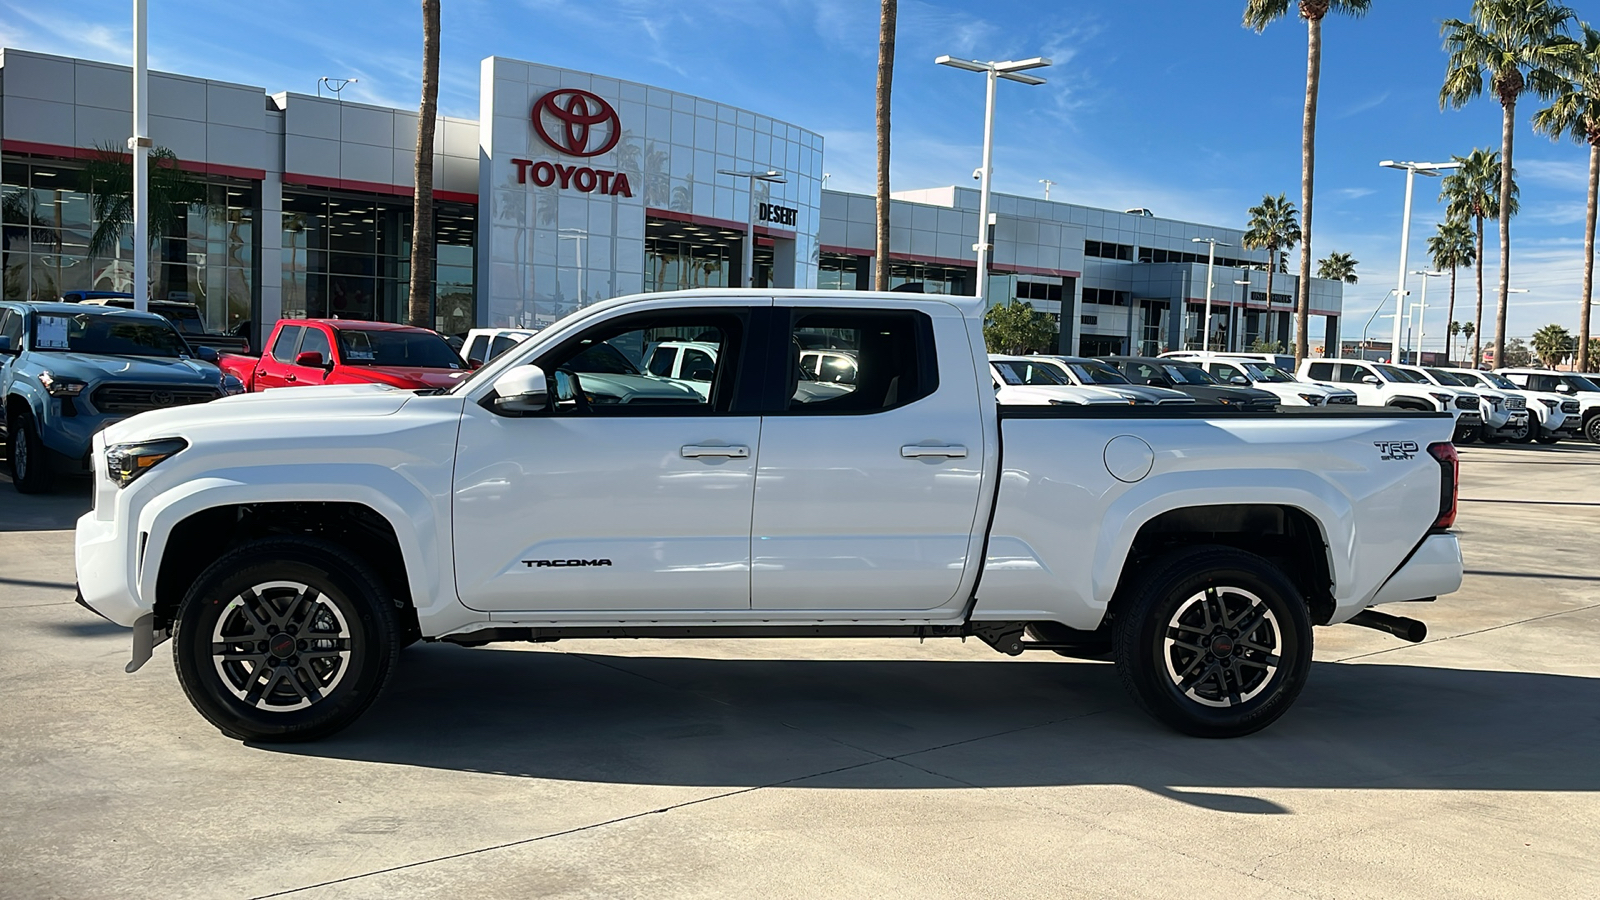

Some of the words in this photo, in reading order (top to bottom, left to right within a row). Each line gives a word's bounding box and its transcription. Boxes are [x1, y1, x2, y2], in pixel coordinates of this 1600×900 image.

[511, 158, 632, 198] TOYOTA
[759, 202, 798, 227] DESERT
[1373, 440, 1419, 455] TRD
[521, 558, 612, 568] TACOMA
